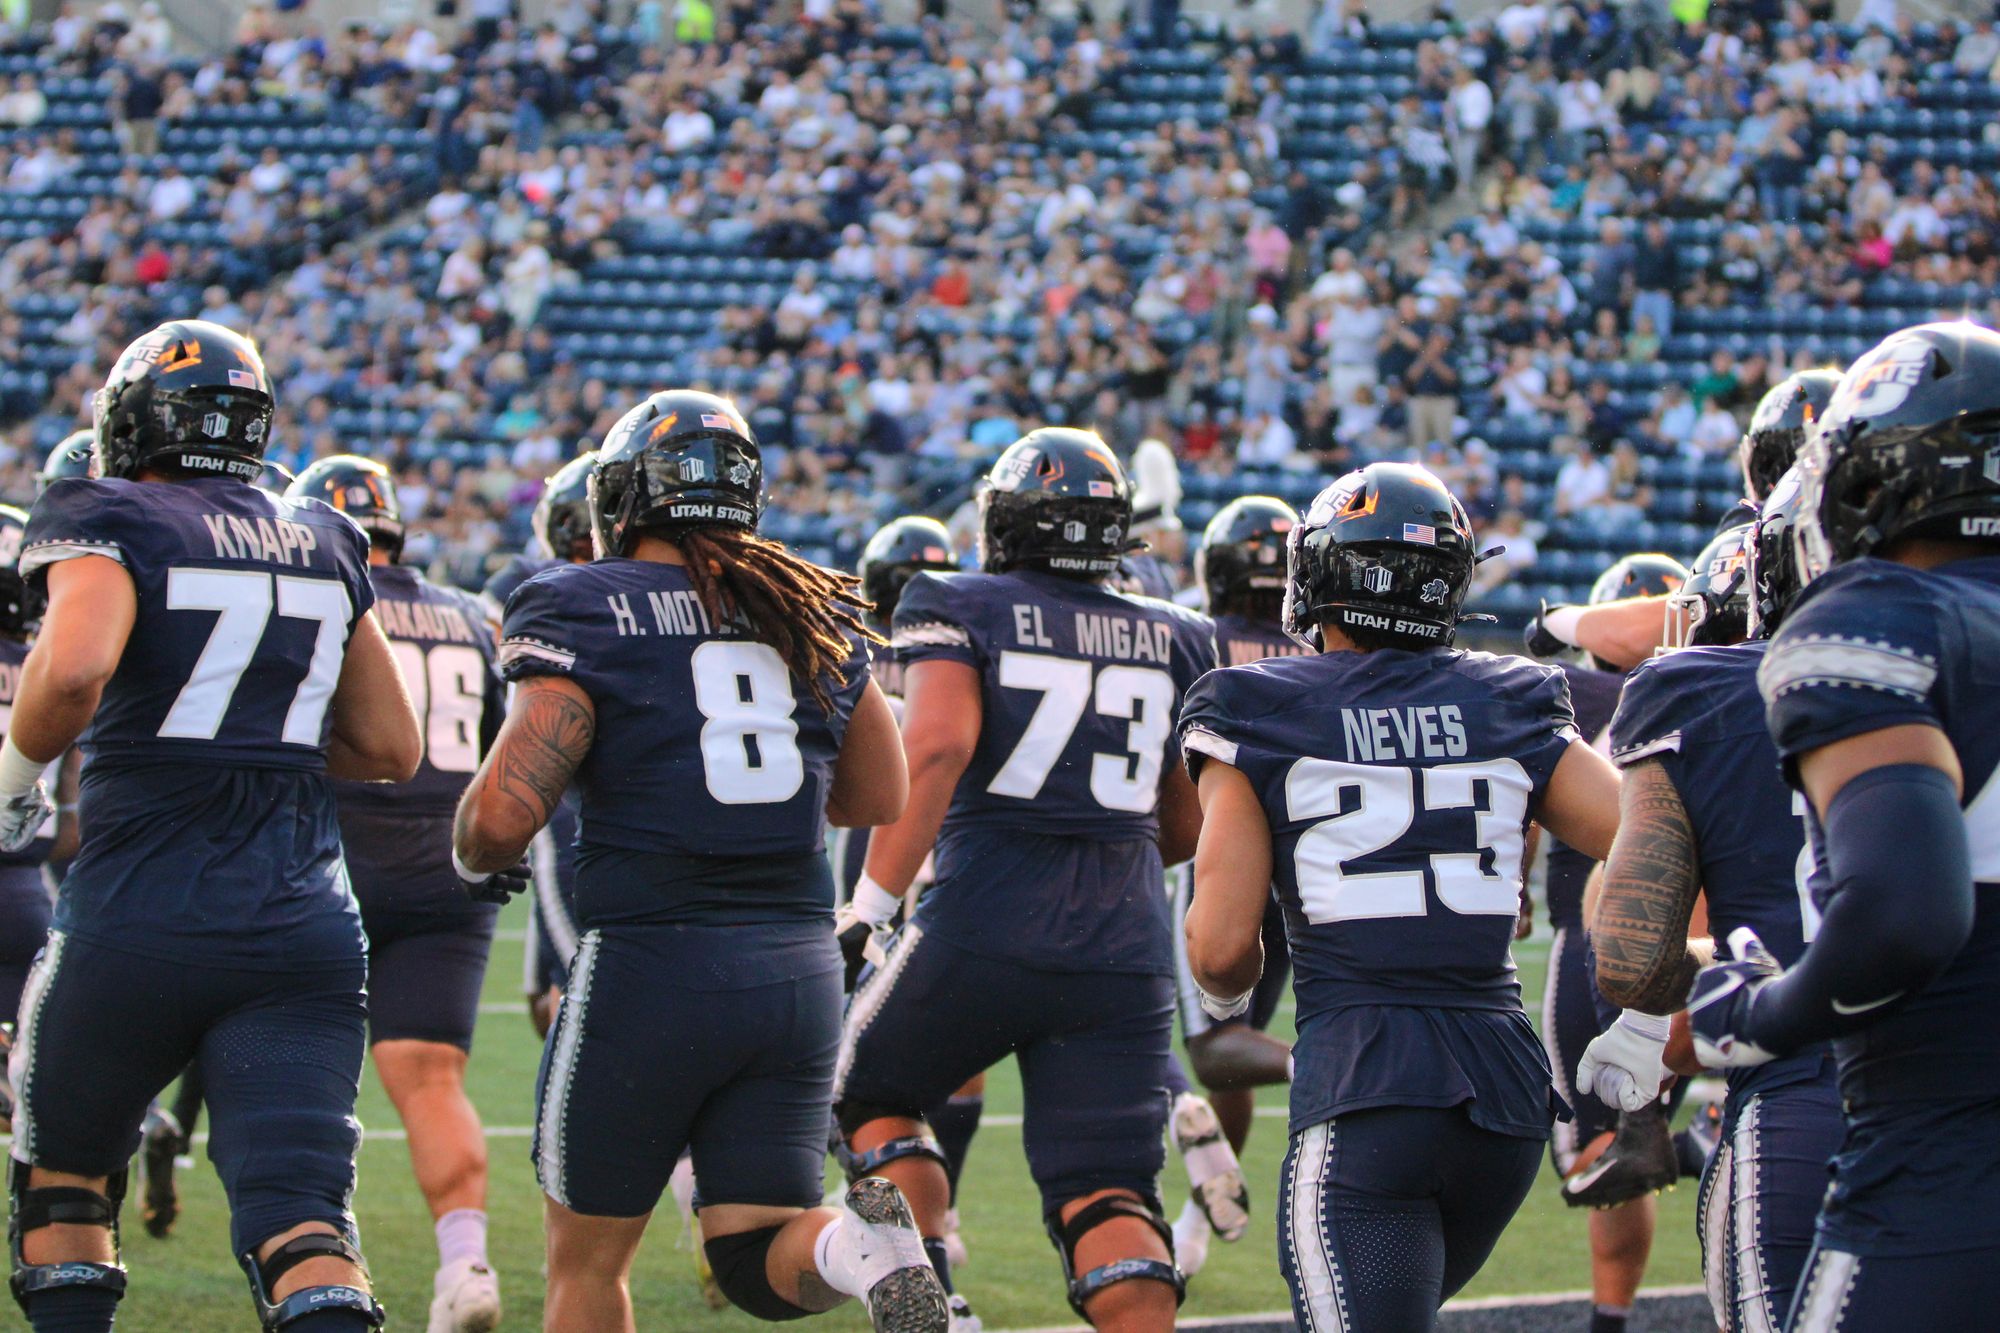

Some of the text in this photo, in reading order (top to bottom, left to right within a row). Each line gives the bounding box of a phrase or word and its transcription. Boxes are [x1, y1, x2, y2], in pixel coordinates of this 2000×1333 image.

[181, 454, 225, 471] UTAH
[670, 505, 753, 525] UTAH STATE
[202, 513, 317, 567] KNAPP
[1050, 558, 1087, 570] UTAH
[1708, 555, 1746, 578] STA
[607, 593, 647, 636] H.
[1012, 604, 1054, 649] EL
[1343, 610, 1441, 639] UTAH STATE
[156, 567, 354, 747] 77
[690, 640, 805, 805] 8
[986, 650, 1175, 814] 73
[1340, 704, 1468, 763] NEVES
[1285, 756, 1534, 926] 23
